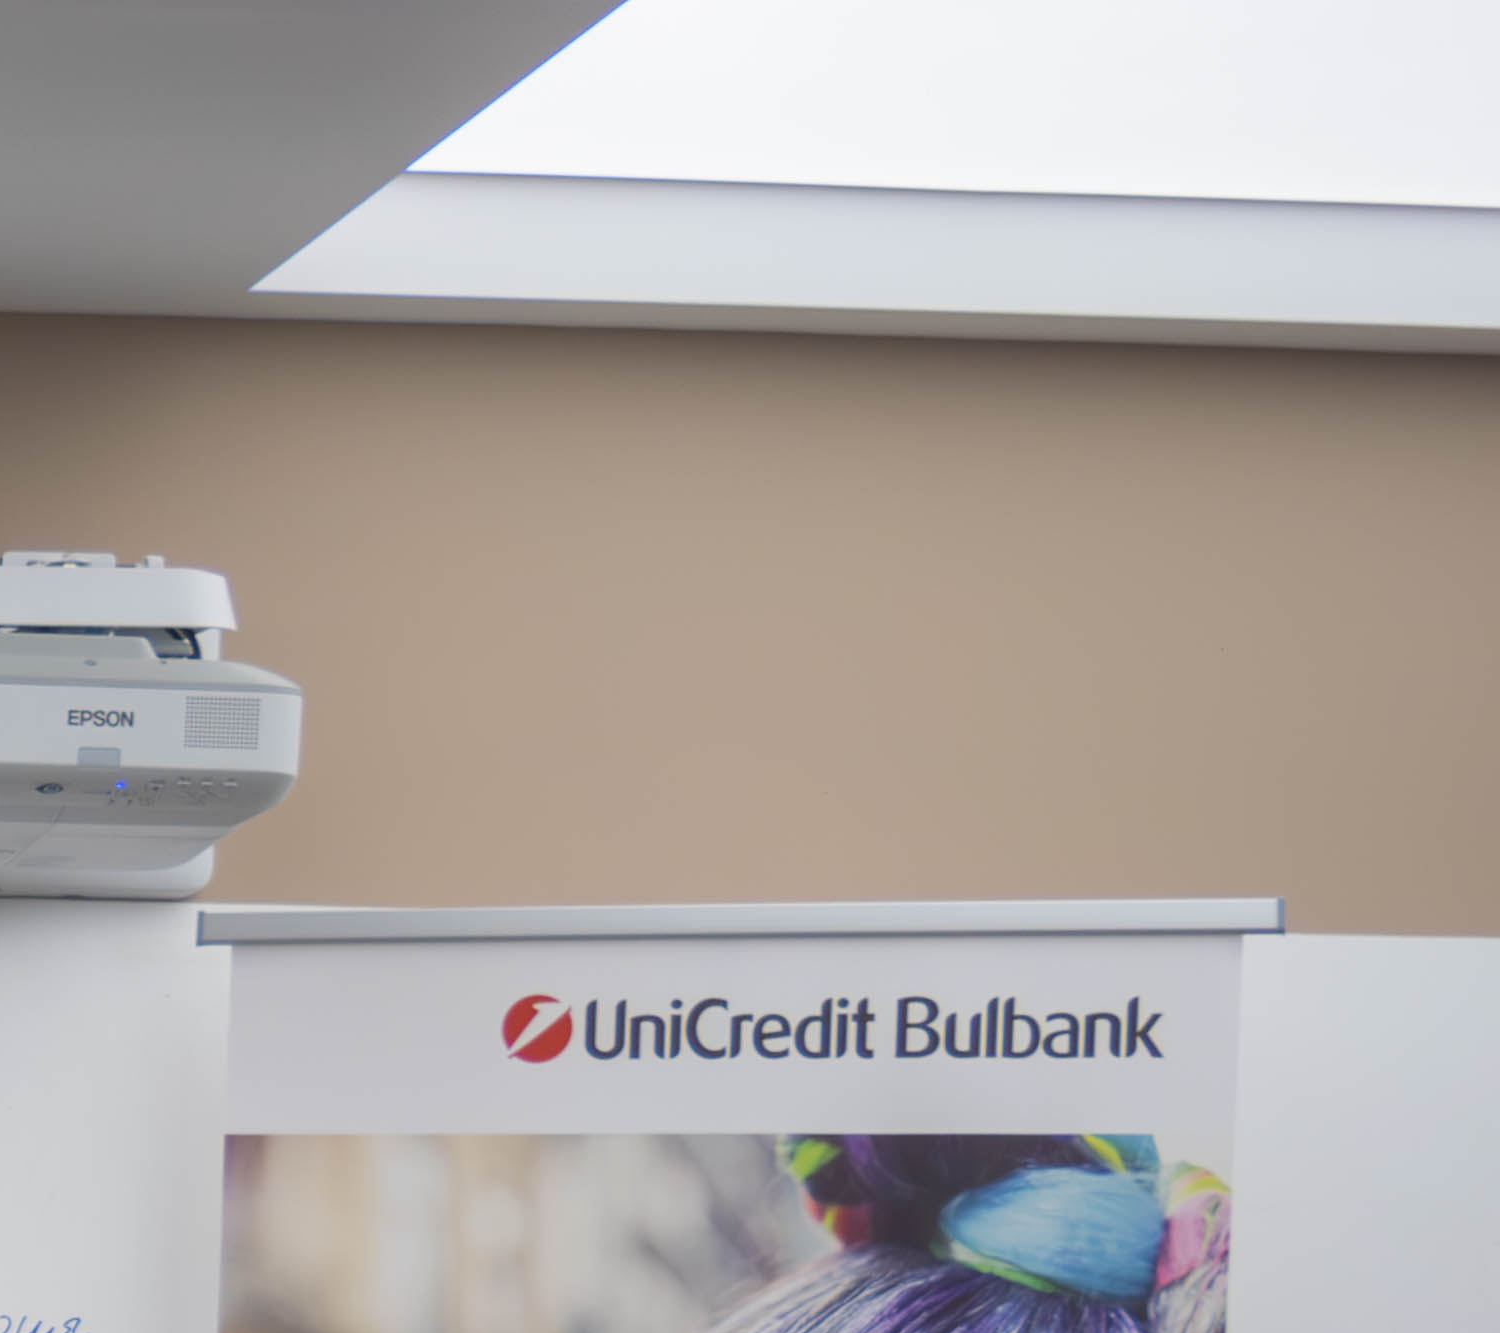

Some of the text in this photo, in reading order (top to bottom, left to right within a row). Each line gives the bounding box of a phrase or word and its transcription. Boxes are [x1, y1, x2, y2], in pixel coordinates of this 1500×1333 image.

[67, 709, 135, 728] EPSON
[584, 996, 1165, 1060] UniCredit Bulbank
